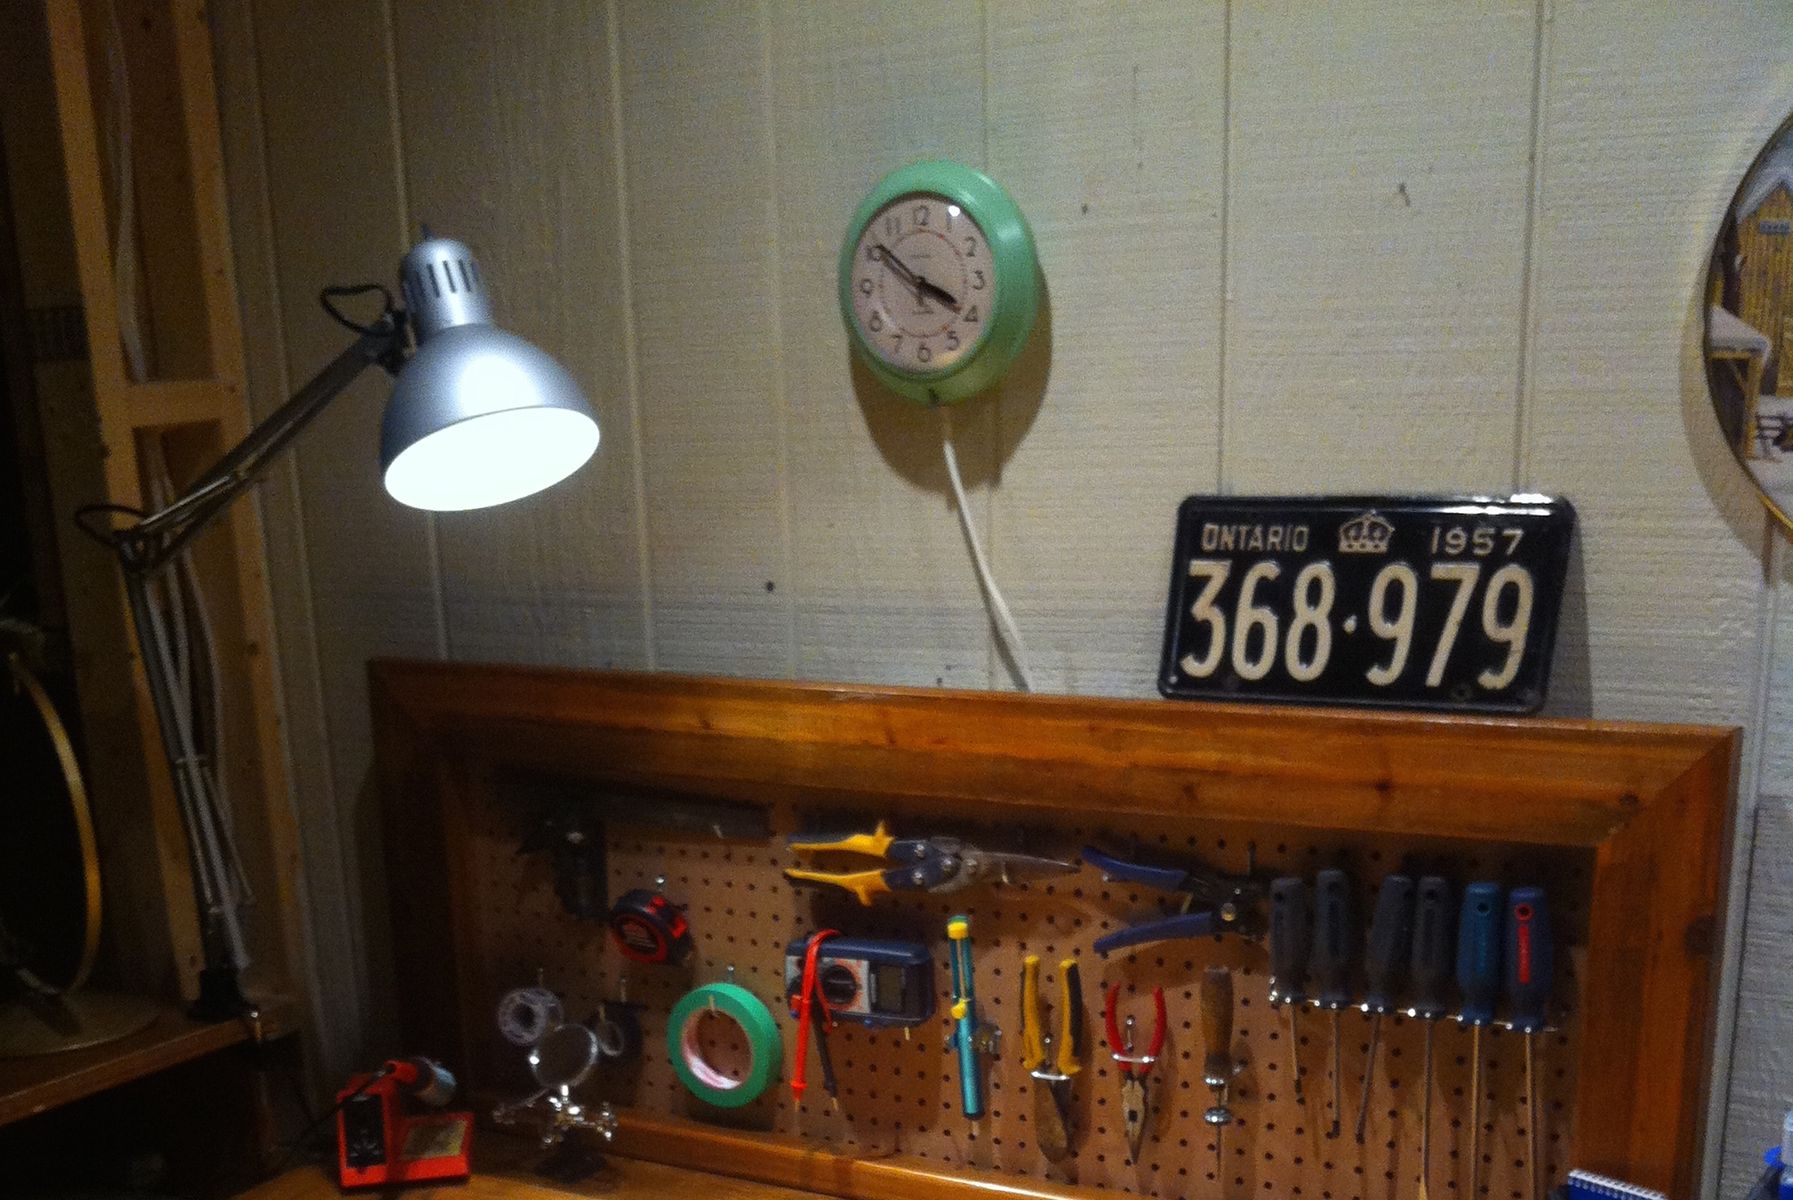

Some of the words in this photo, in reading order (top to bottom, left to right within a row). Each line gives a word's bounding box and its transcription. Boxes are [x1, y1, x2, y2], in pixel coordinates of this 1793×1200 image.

[912, 204, 930, 226] 12
[965, 236, 976, 257] 2
[860, 278, 874, 295] 9
[974, 270, 985, 290] 3
[869, 310, 882, 332] 8
[964, 305, 978, 323] 4
[891, 334, 903, 353] 7
[947, 331, 959, 351] 5
[917, 343, 932, 363] 6
[1201, 523, 1310, 554] ONTARIO
[1431, 526, 1525, 556] 1957
